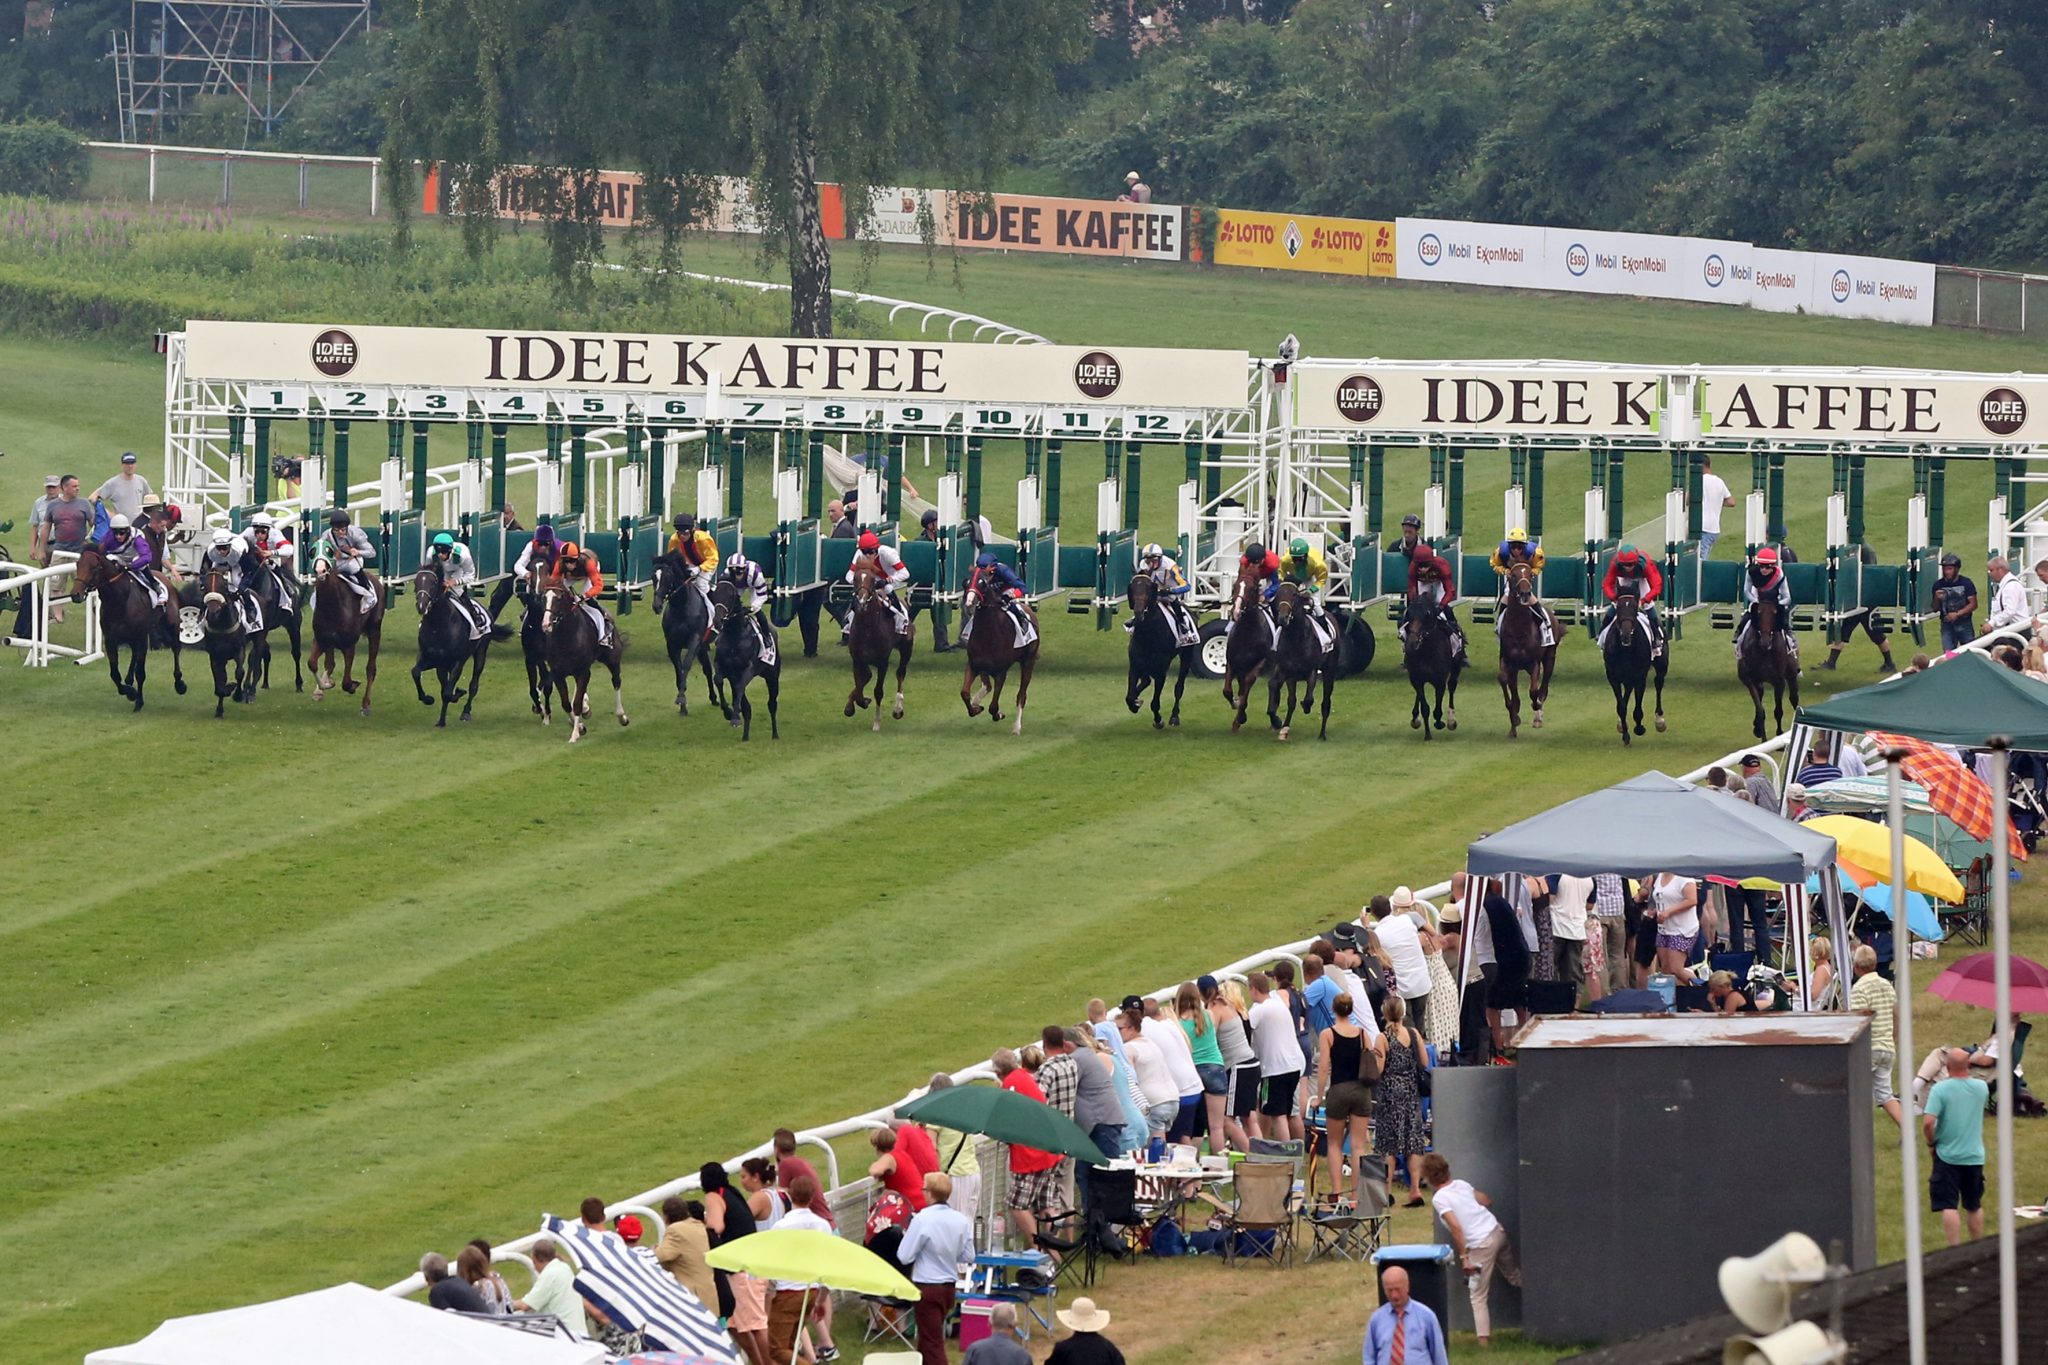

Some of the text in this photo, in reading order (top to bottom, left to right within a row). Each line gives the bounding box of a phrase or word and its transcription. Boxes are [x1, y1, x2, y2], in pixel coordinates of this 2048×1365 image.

[957, 202, 1174, 252] IDEE KAFFEE
[1236, 223, 1274, 245] LOTTO
[1326, 230, 1363, 251] LOTTO
[1372, 252, 1393, 263] LOTTO
[1421, 242, 1523, 264] Esso Mobil ExxonMobil
[1569, 252, 1666, 275] Esso Mobil ExxonMobil
[1707, 263, 1796, 291] Esso Mobil ExxonMobil
[1834, 278, 1917, 302] Esso Mobil ExxonMobil
[316, 342, 354, 356] IDEE
[316, 355, 354, 364] KAFFEE
[485, 335, 947, 393] IDEE KAFFEE
[1079, 364, 1117, 378] IDEE
[1079, 377, 1117, 387] KAFFEE
[270, 391, 283, 405] 1
[345, 391, 367, 405] 2
[424, 394, 447, 408] 3
[1340, 388, 1378, 402] IDEE
[1422, 378, 1592, 425] IDEE
[502, 396, 526, 410] 4
[583, 399, 604, 412] 5
[665, 401, 686, 414] 6
[743, 403, 765, 416] 7
[1340, 401, 1379, 410] KAFFEE
[1984, 400, 2023, 414] IDEE
[824, 406, 845, 419] 8
[902, 408, 923, 421] 9
[976, 411, 1012, 425] 10
[1984, 414, 2023, 423] KAFFEE
[1062, 413, 1088, 427] 11
[1135, 415, 1169, 429] 12
